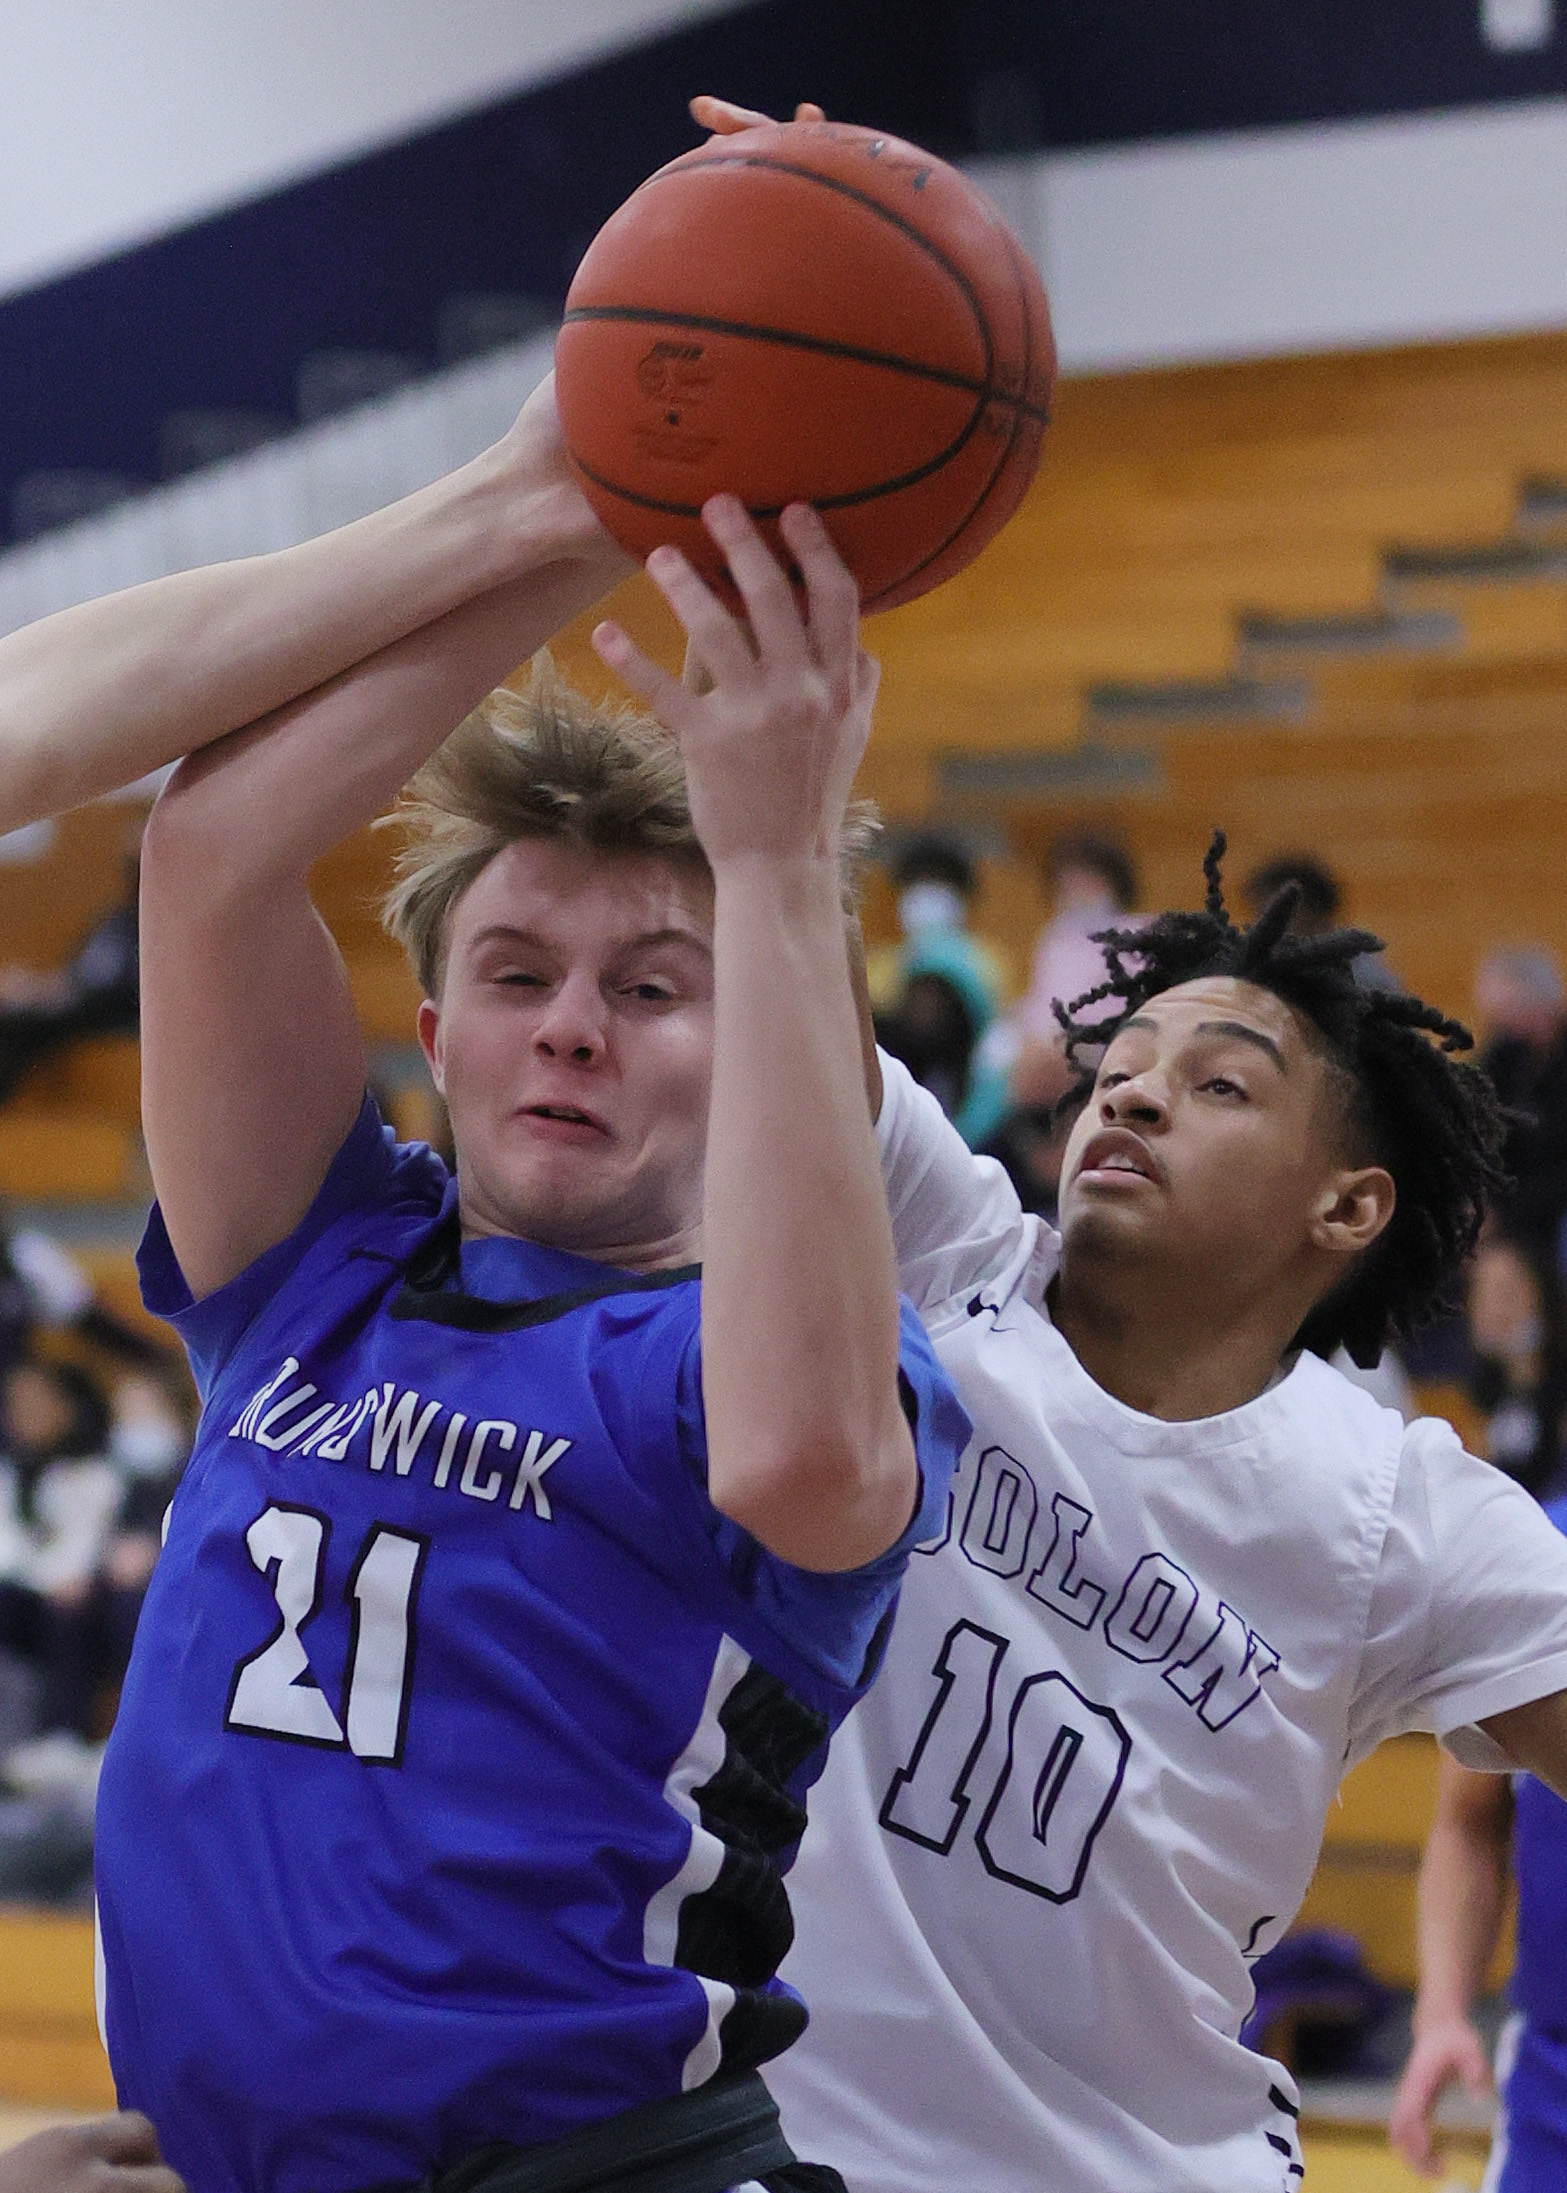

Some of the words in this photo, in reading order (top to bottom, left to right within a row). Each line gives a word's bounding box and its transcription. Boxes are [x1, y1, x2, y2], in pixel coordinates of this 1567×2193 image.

[224, 1499, 431, 1768] 21
[913, 1445, 1281, 1733] OLON
[878, 1618, 1132, 1905] 10
